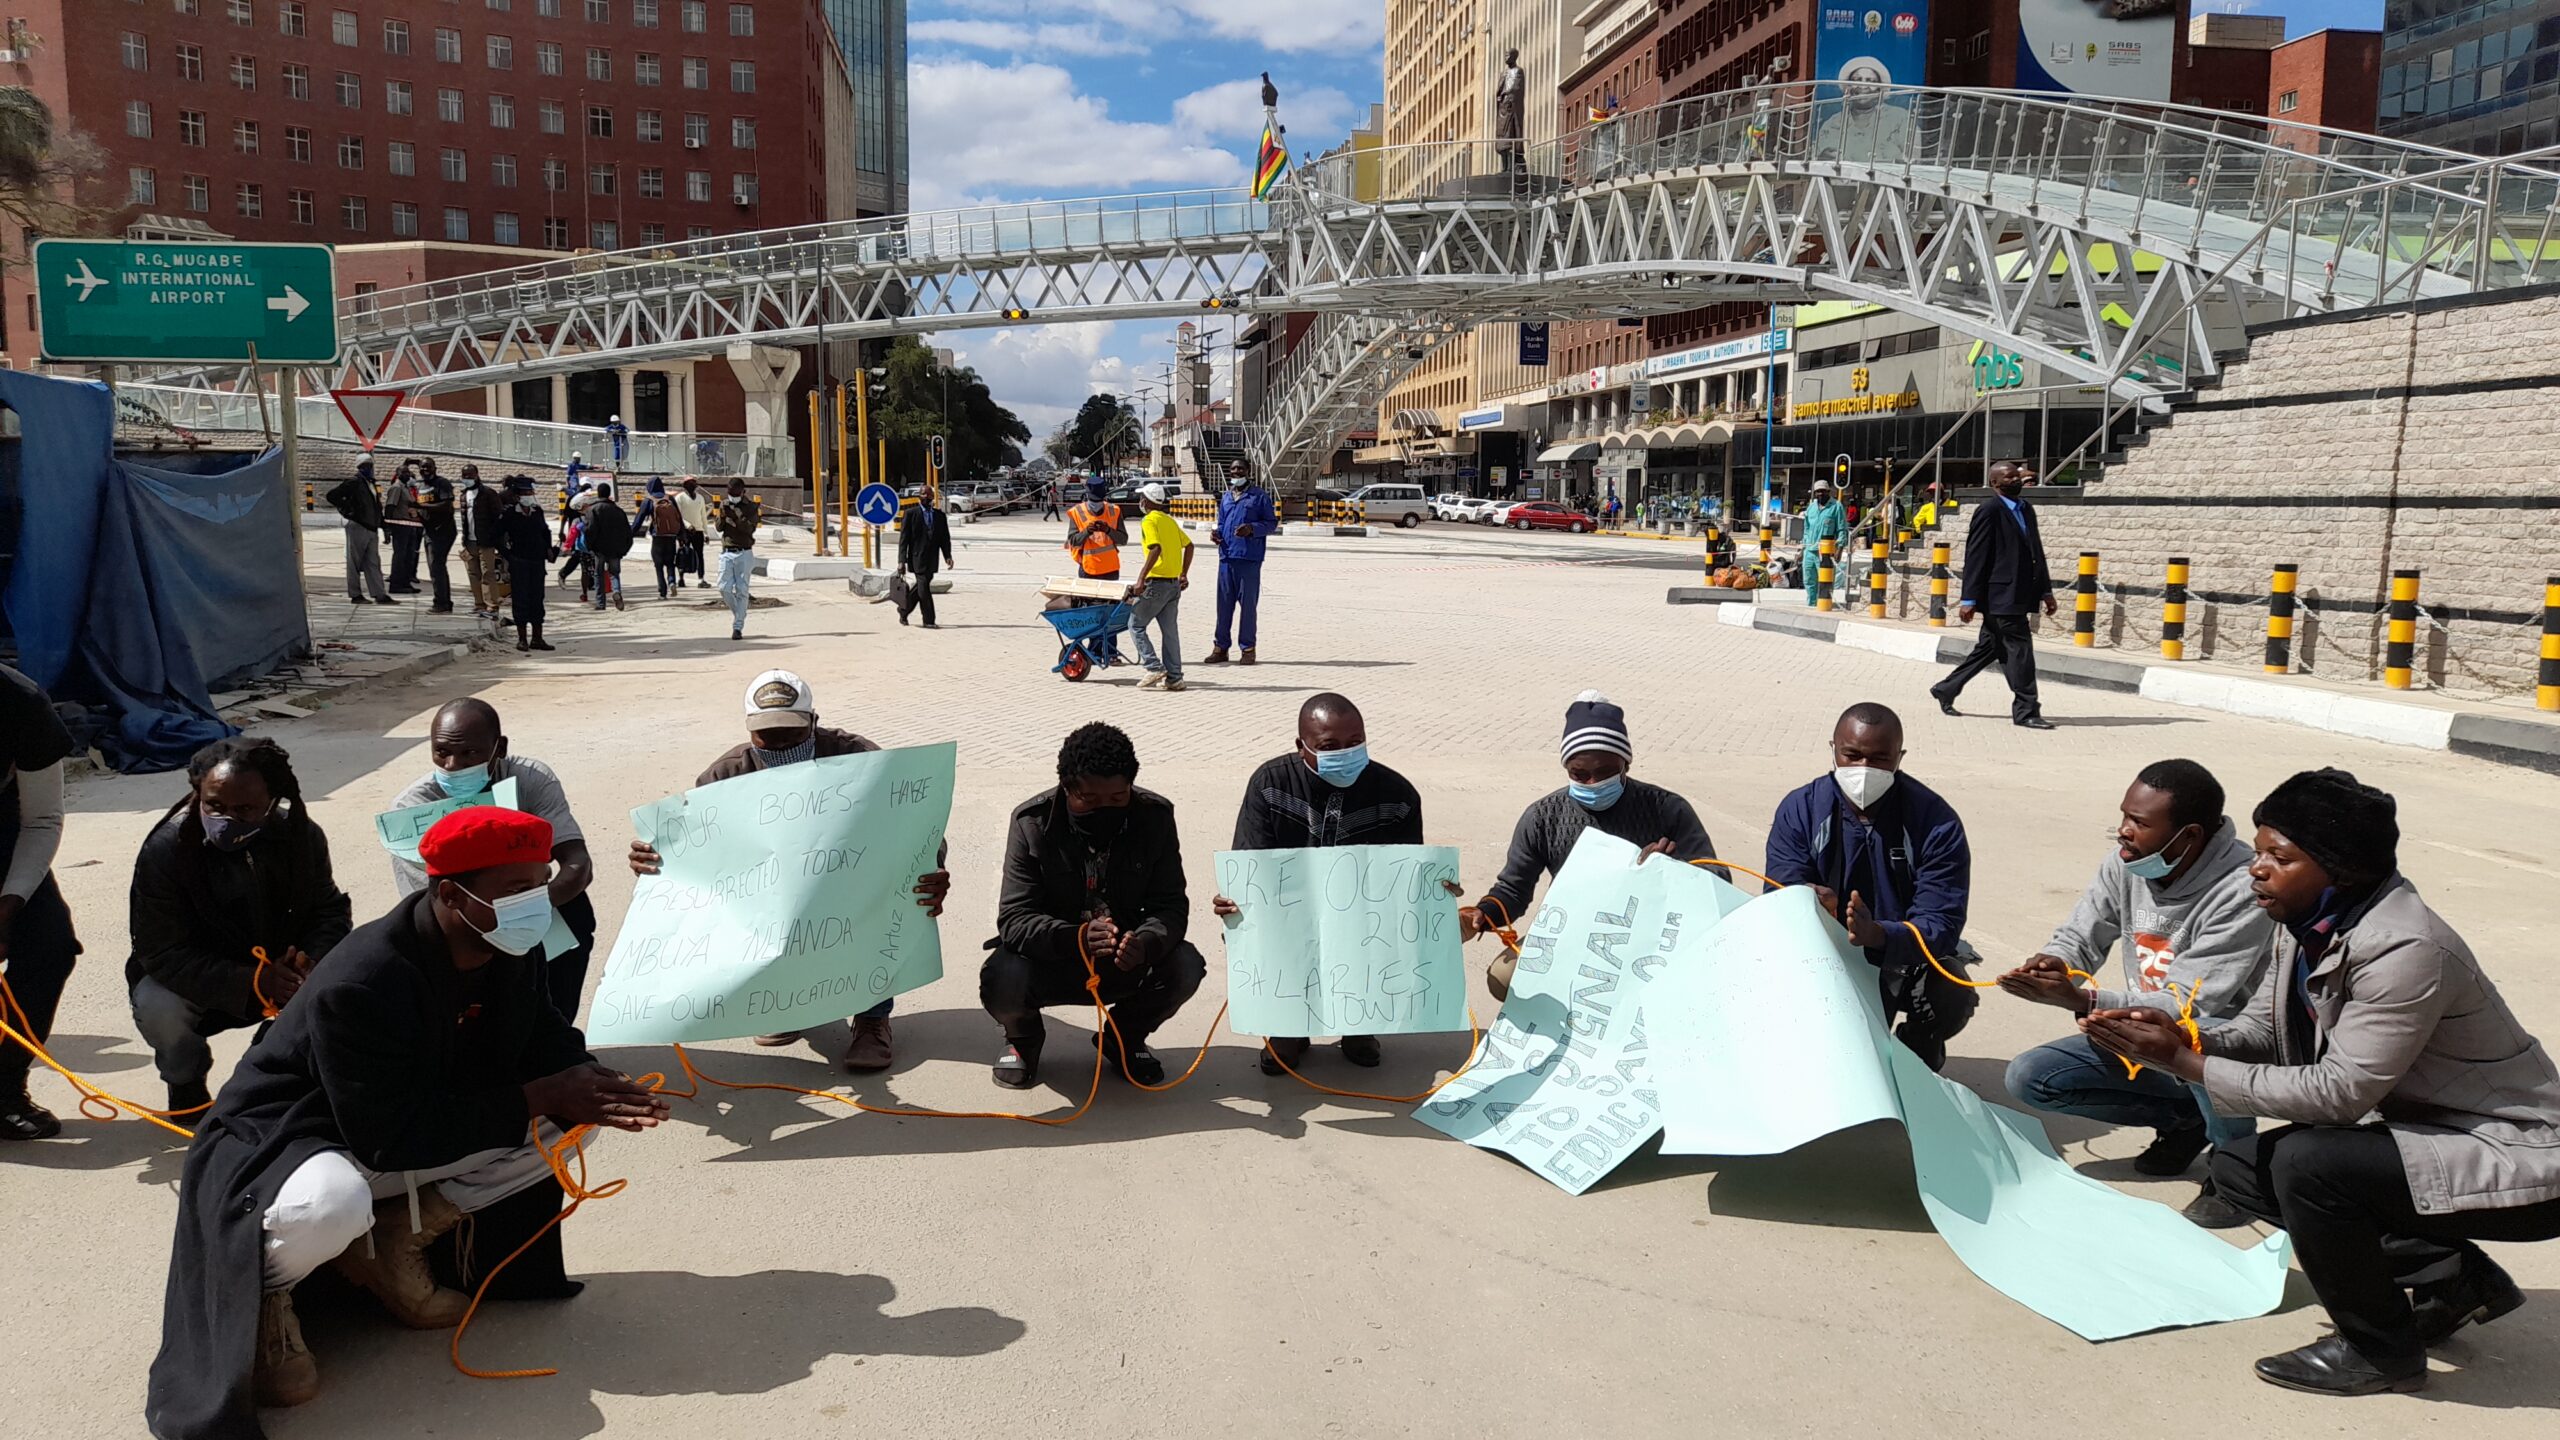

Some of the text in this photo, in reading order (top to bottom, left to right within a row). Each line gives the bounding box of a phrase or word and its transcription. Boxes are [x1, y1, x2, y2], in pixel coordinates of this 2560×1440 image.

[122, 272, 255, 286] INTERNATIONAL
[173, 254, 243, 267] MUGABE
[150, 291, 226, 304] AIRPORT
[1777, 313, 1793, 323] nbs
[1662, 342, 1744, 369] ZIMBABWE TOURISM AUTHORITY
[1975, 343, 2024, 389] nbs
[1792, 390, 1919, 417] samora machel avenue
[637, 806, 722, 857] YOUR
[640, 846, 868, 912] RESURRECTED TODAY
[1225, 856, 1302, 907] PRE
[612, 916, 853, 977] MBUYA NEHANDA
[1360, 910, 1445, 948] 2018
[601, 990, 655, 1027] SAVE
[671, 994, 725, 1021] OUR
[747, 975, 858, 1016] EDUCATION
[1232, 960, 1432, 1000] SALARIES
[1523, 895, 1640, 1088] SIGNAL
[1430, 903, 1569, 1120] GIVE US
[1505, 1105, 1580, 1150] TO
[1544, 1075, 1662, 1189] EDUCA
